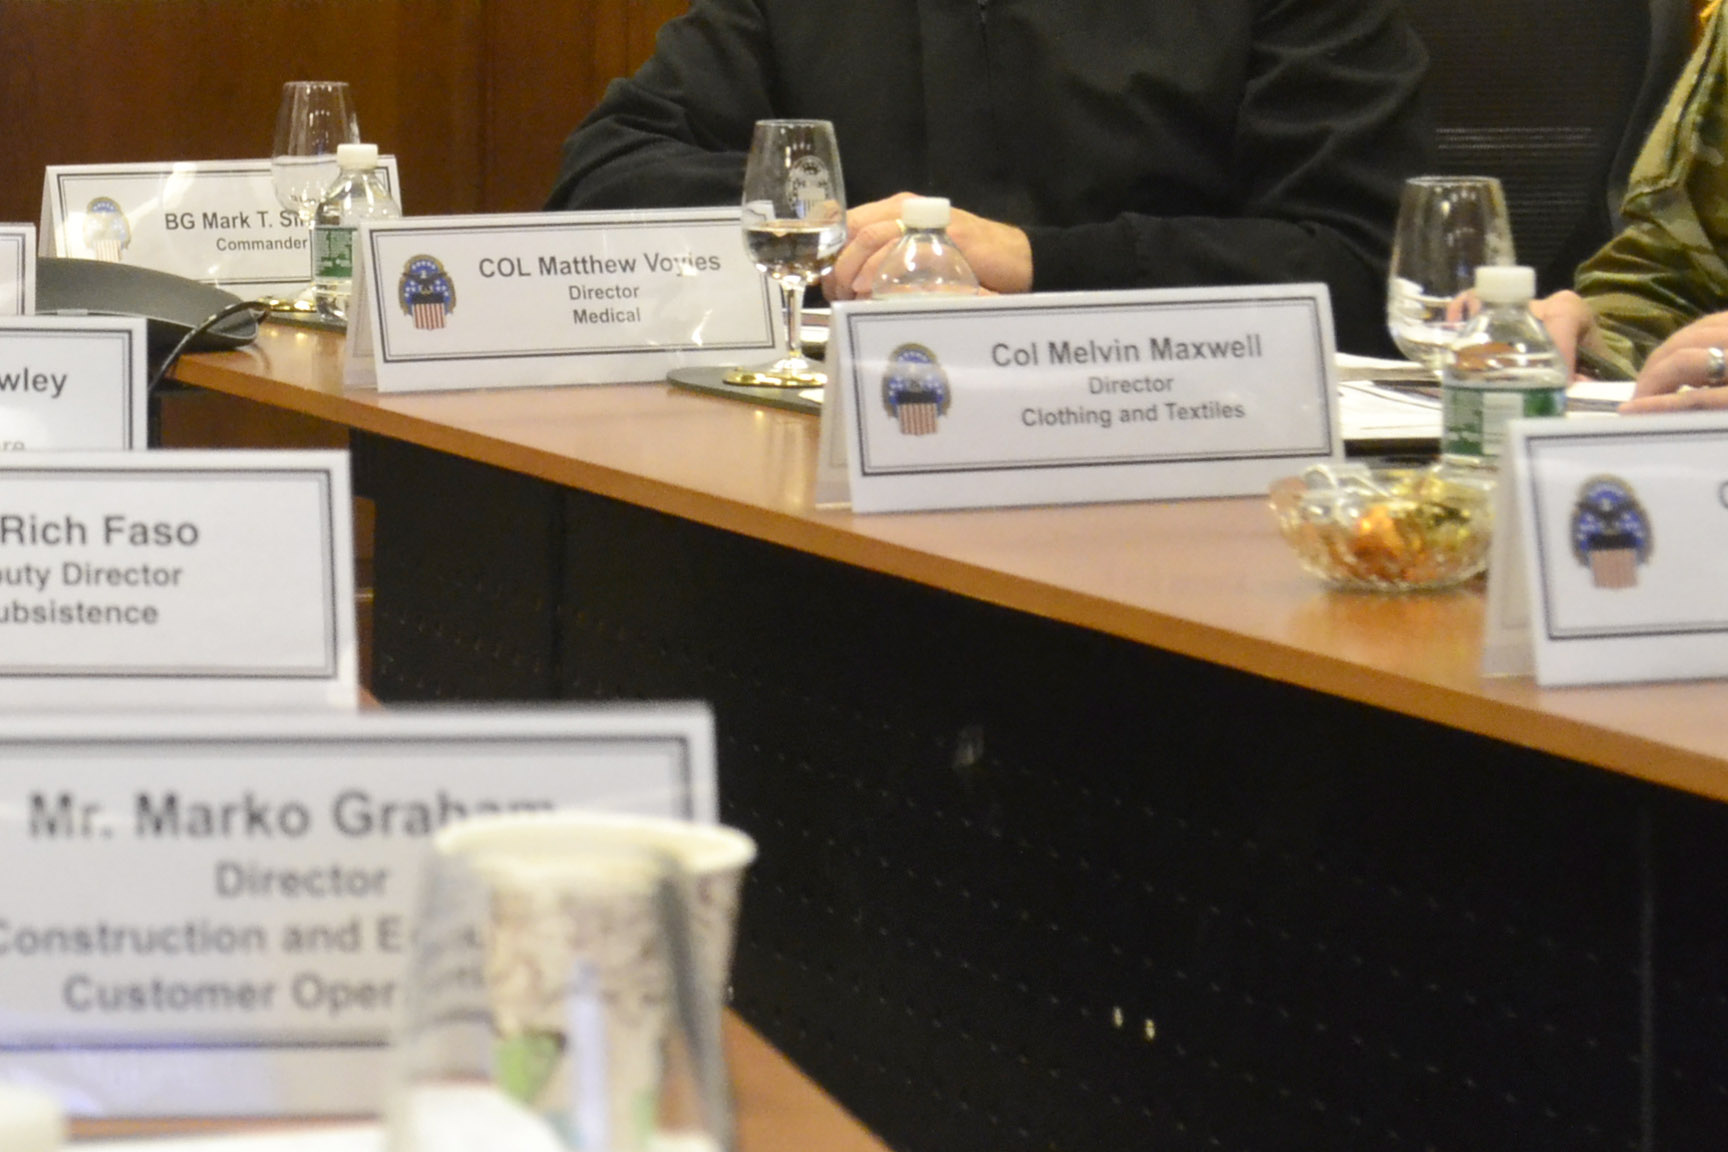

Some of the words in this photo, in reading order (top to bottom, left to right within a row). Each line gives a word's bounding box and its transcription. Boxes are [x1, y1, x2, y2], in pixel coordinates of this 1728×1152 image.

[165, 212, 195, 230] BG
[202, 211, 251, 230] Mark
[256, 210, 273, 228] T.
[216, 236, 308, 252] Commander
[478, 257, 531, 278] COL
[538, 254, 637, 277] Matthew
[568, 284, 640, 301] Director
[573, 307, 641, 325] Medical
[991, 341, 1039, 367] Col
[1048, 338, 1140, 365] Melvin
[1149, 333, 1263, 361] Maxwell
[1088, 375, 1174, 395] Director
[1021, 405, 1112, 429] Clothing
[1119, 403, 1158, 423] and
[1165, 401, 1246, 421] Textiles
[0, 515, 88, 546] Rich
[103, 515, 200, 546] Faso
[62, 561, 183, 587] Director
[27, 792, 114, 838] Mr.
[134, 791, 312, 839] Marko
[332, 789, 555, 837] Grah
[215, 861, 390, 898] Director
[282, 916, 361, 956] and
[62, 974, 275, 1014] Customer
